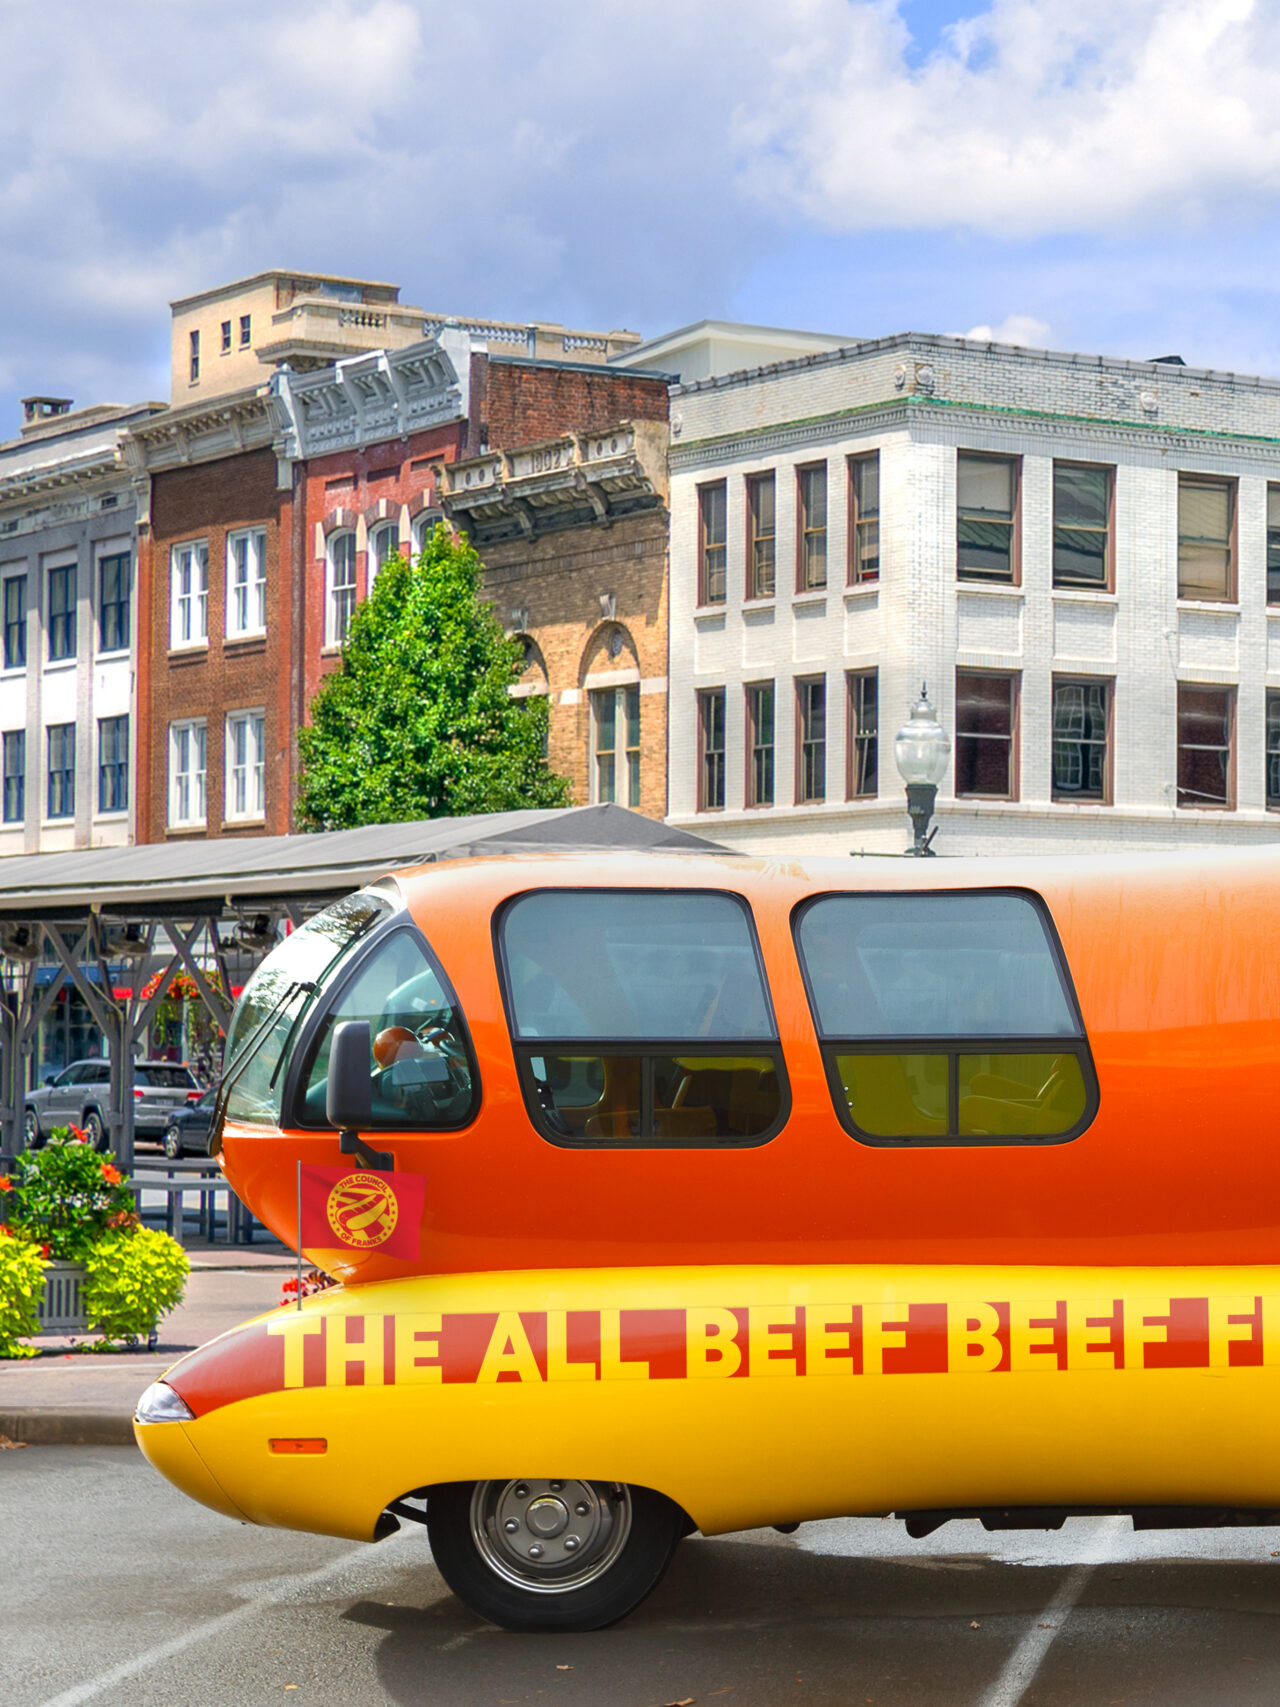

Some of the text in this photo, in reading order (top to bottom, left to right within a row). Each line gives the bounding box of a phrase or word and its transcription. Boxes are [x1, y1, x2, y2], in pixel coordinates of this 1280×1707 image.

[339, 1175, 388, 1193] THE COUNCIL
[340, 1233, 382, 1246] OF FRANKS
[267, 1314, 443, 1388] THE
[475, 1309, 650, 1383] ALL
[686, 1303, 910, 1379] BEEF
[946, 1298, 1171, 1374] BEEF
